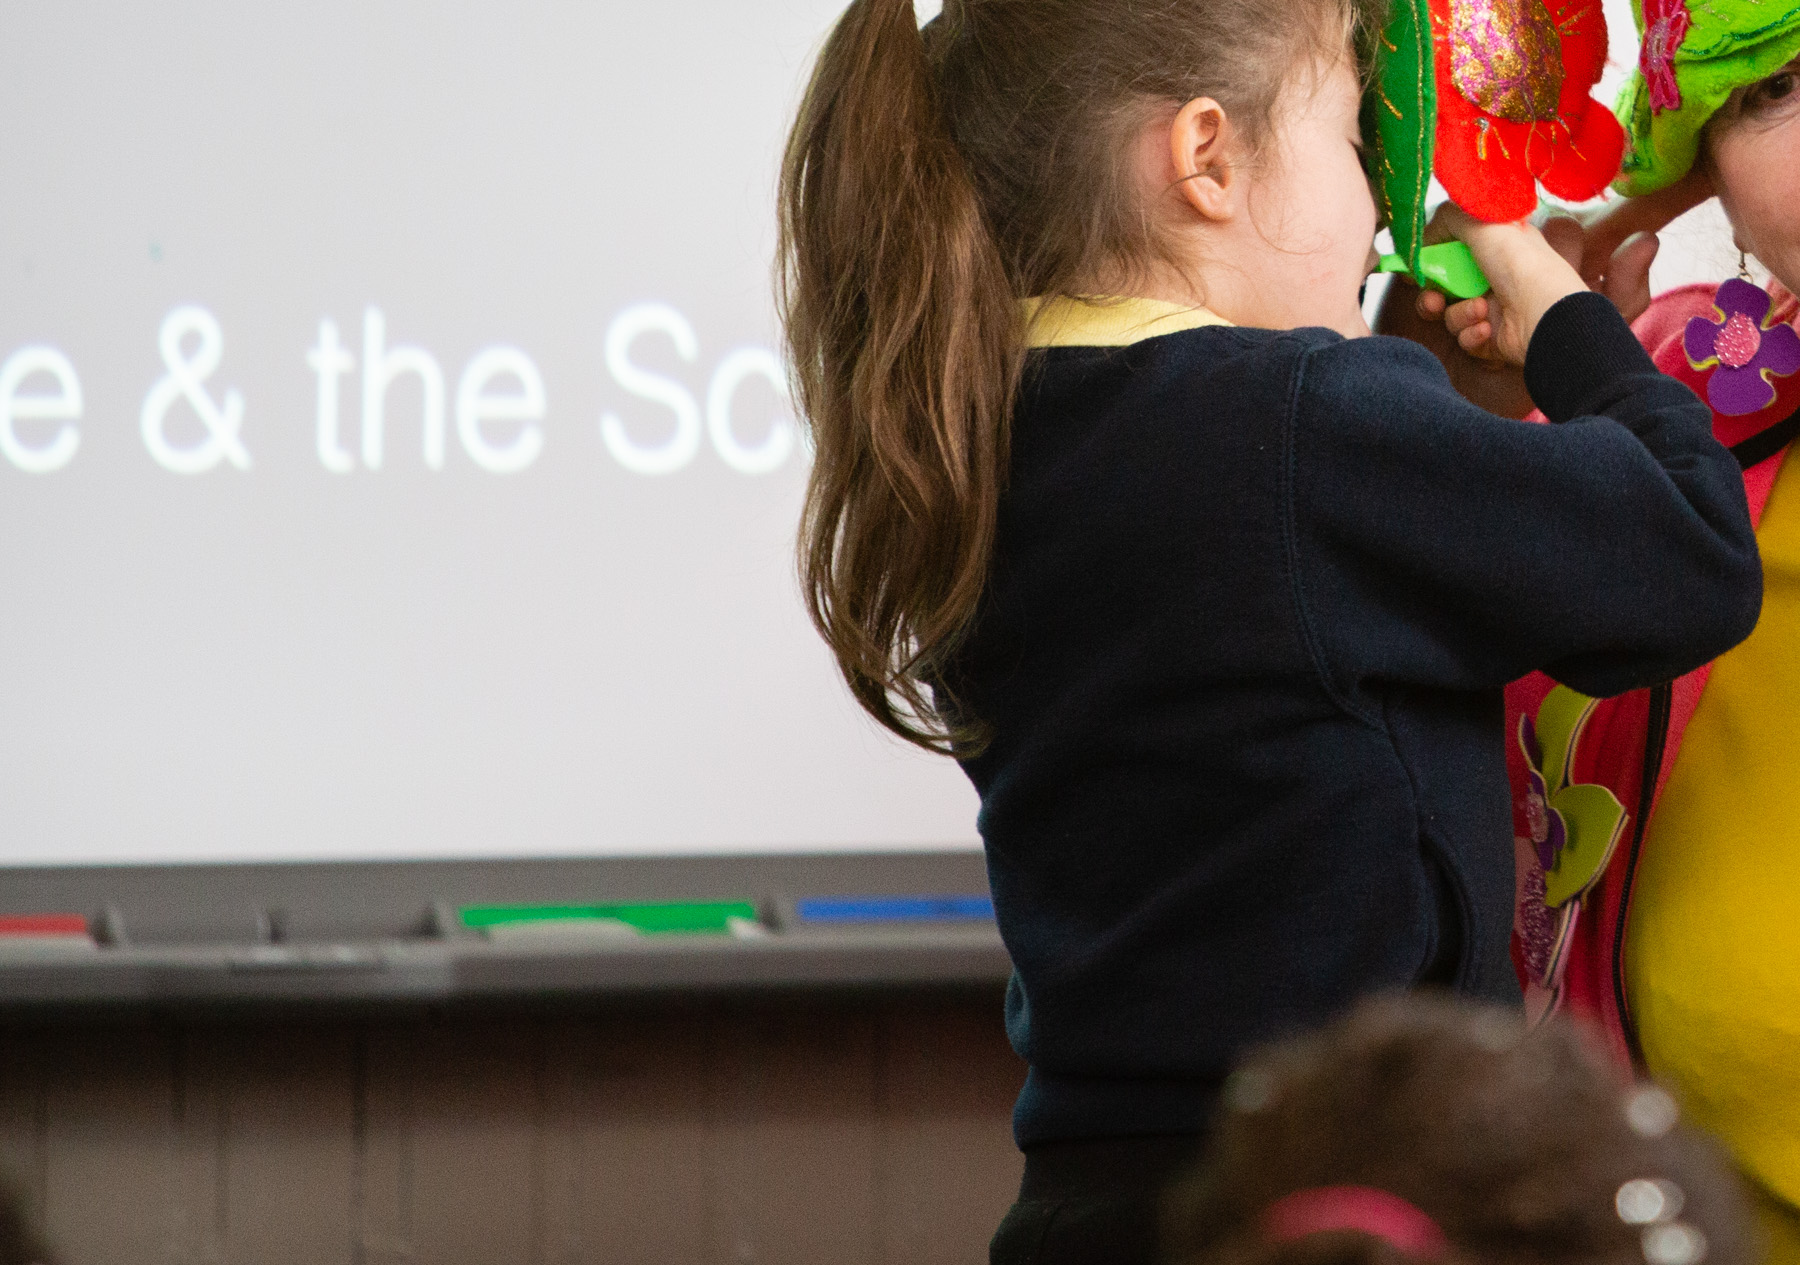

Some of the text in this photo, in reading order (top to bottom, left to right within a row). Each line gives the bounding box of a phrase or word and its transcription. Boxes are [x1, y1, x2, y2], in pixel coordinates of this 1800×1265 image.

[0, 301, 816, 475] e & the Sc
